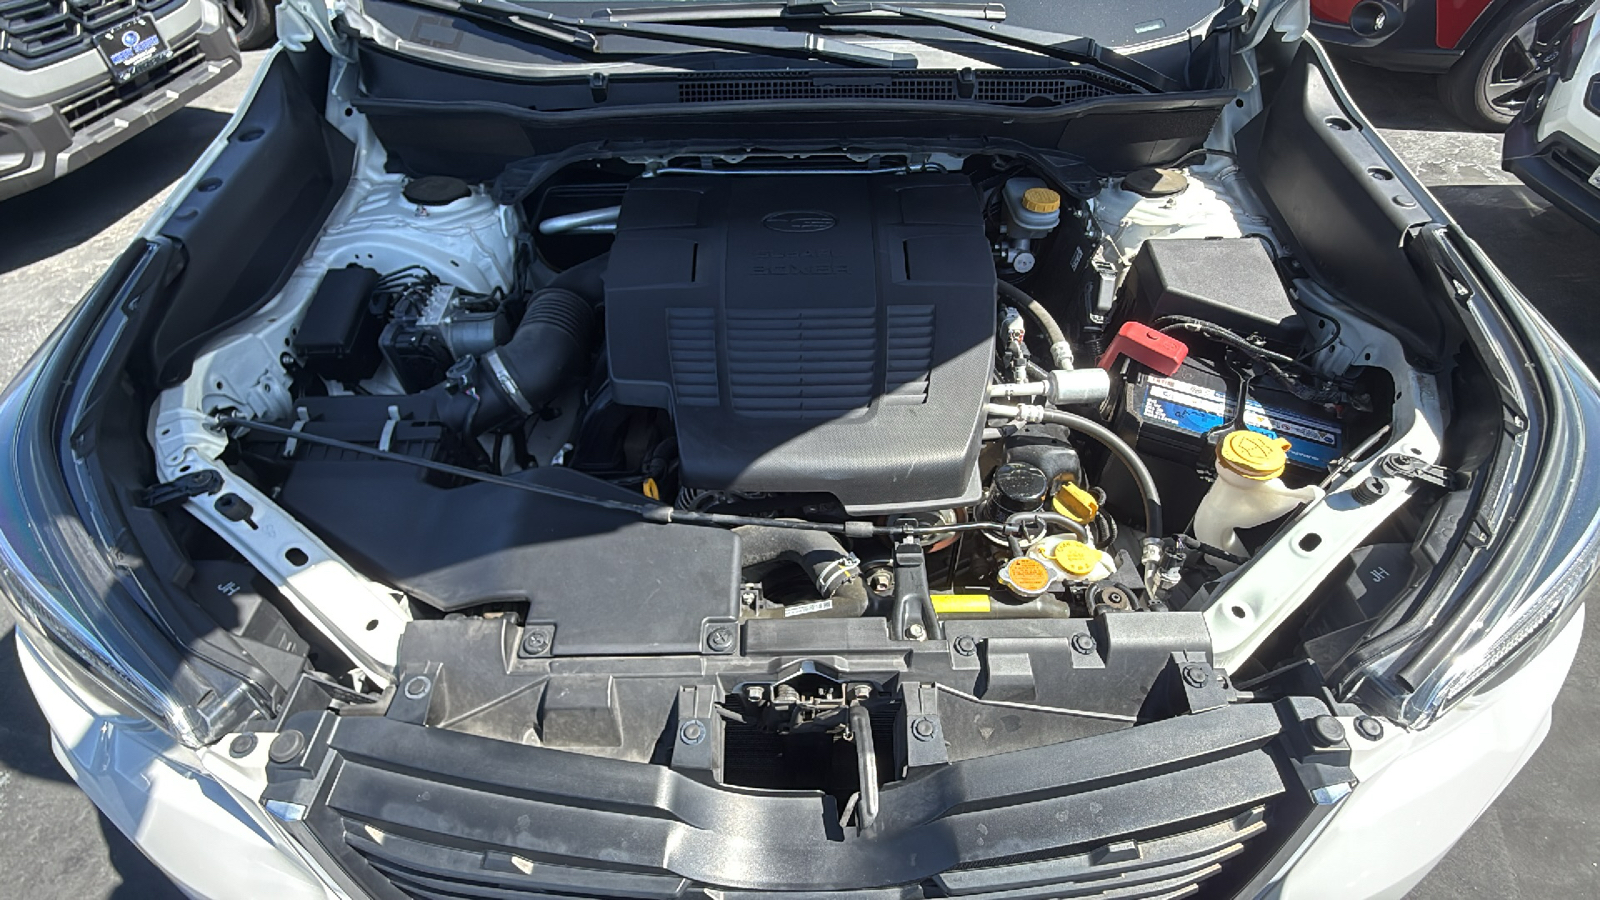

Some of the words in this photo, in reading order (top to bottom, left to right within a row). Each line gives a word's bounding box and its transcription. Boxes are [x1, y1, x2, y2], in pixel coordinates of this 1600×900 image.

[750, 264, 852, 276] BOXER
[1370, 566, 1390, 582] JH
[217, 581, 240, 596] JH
